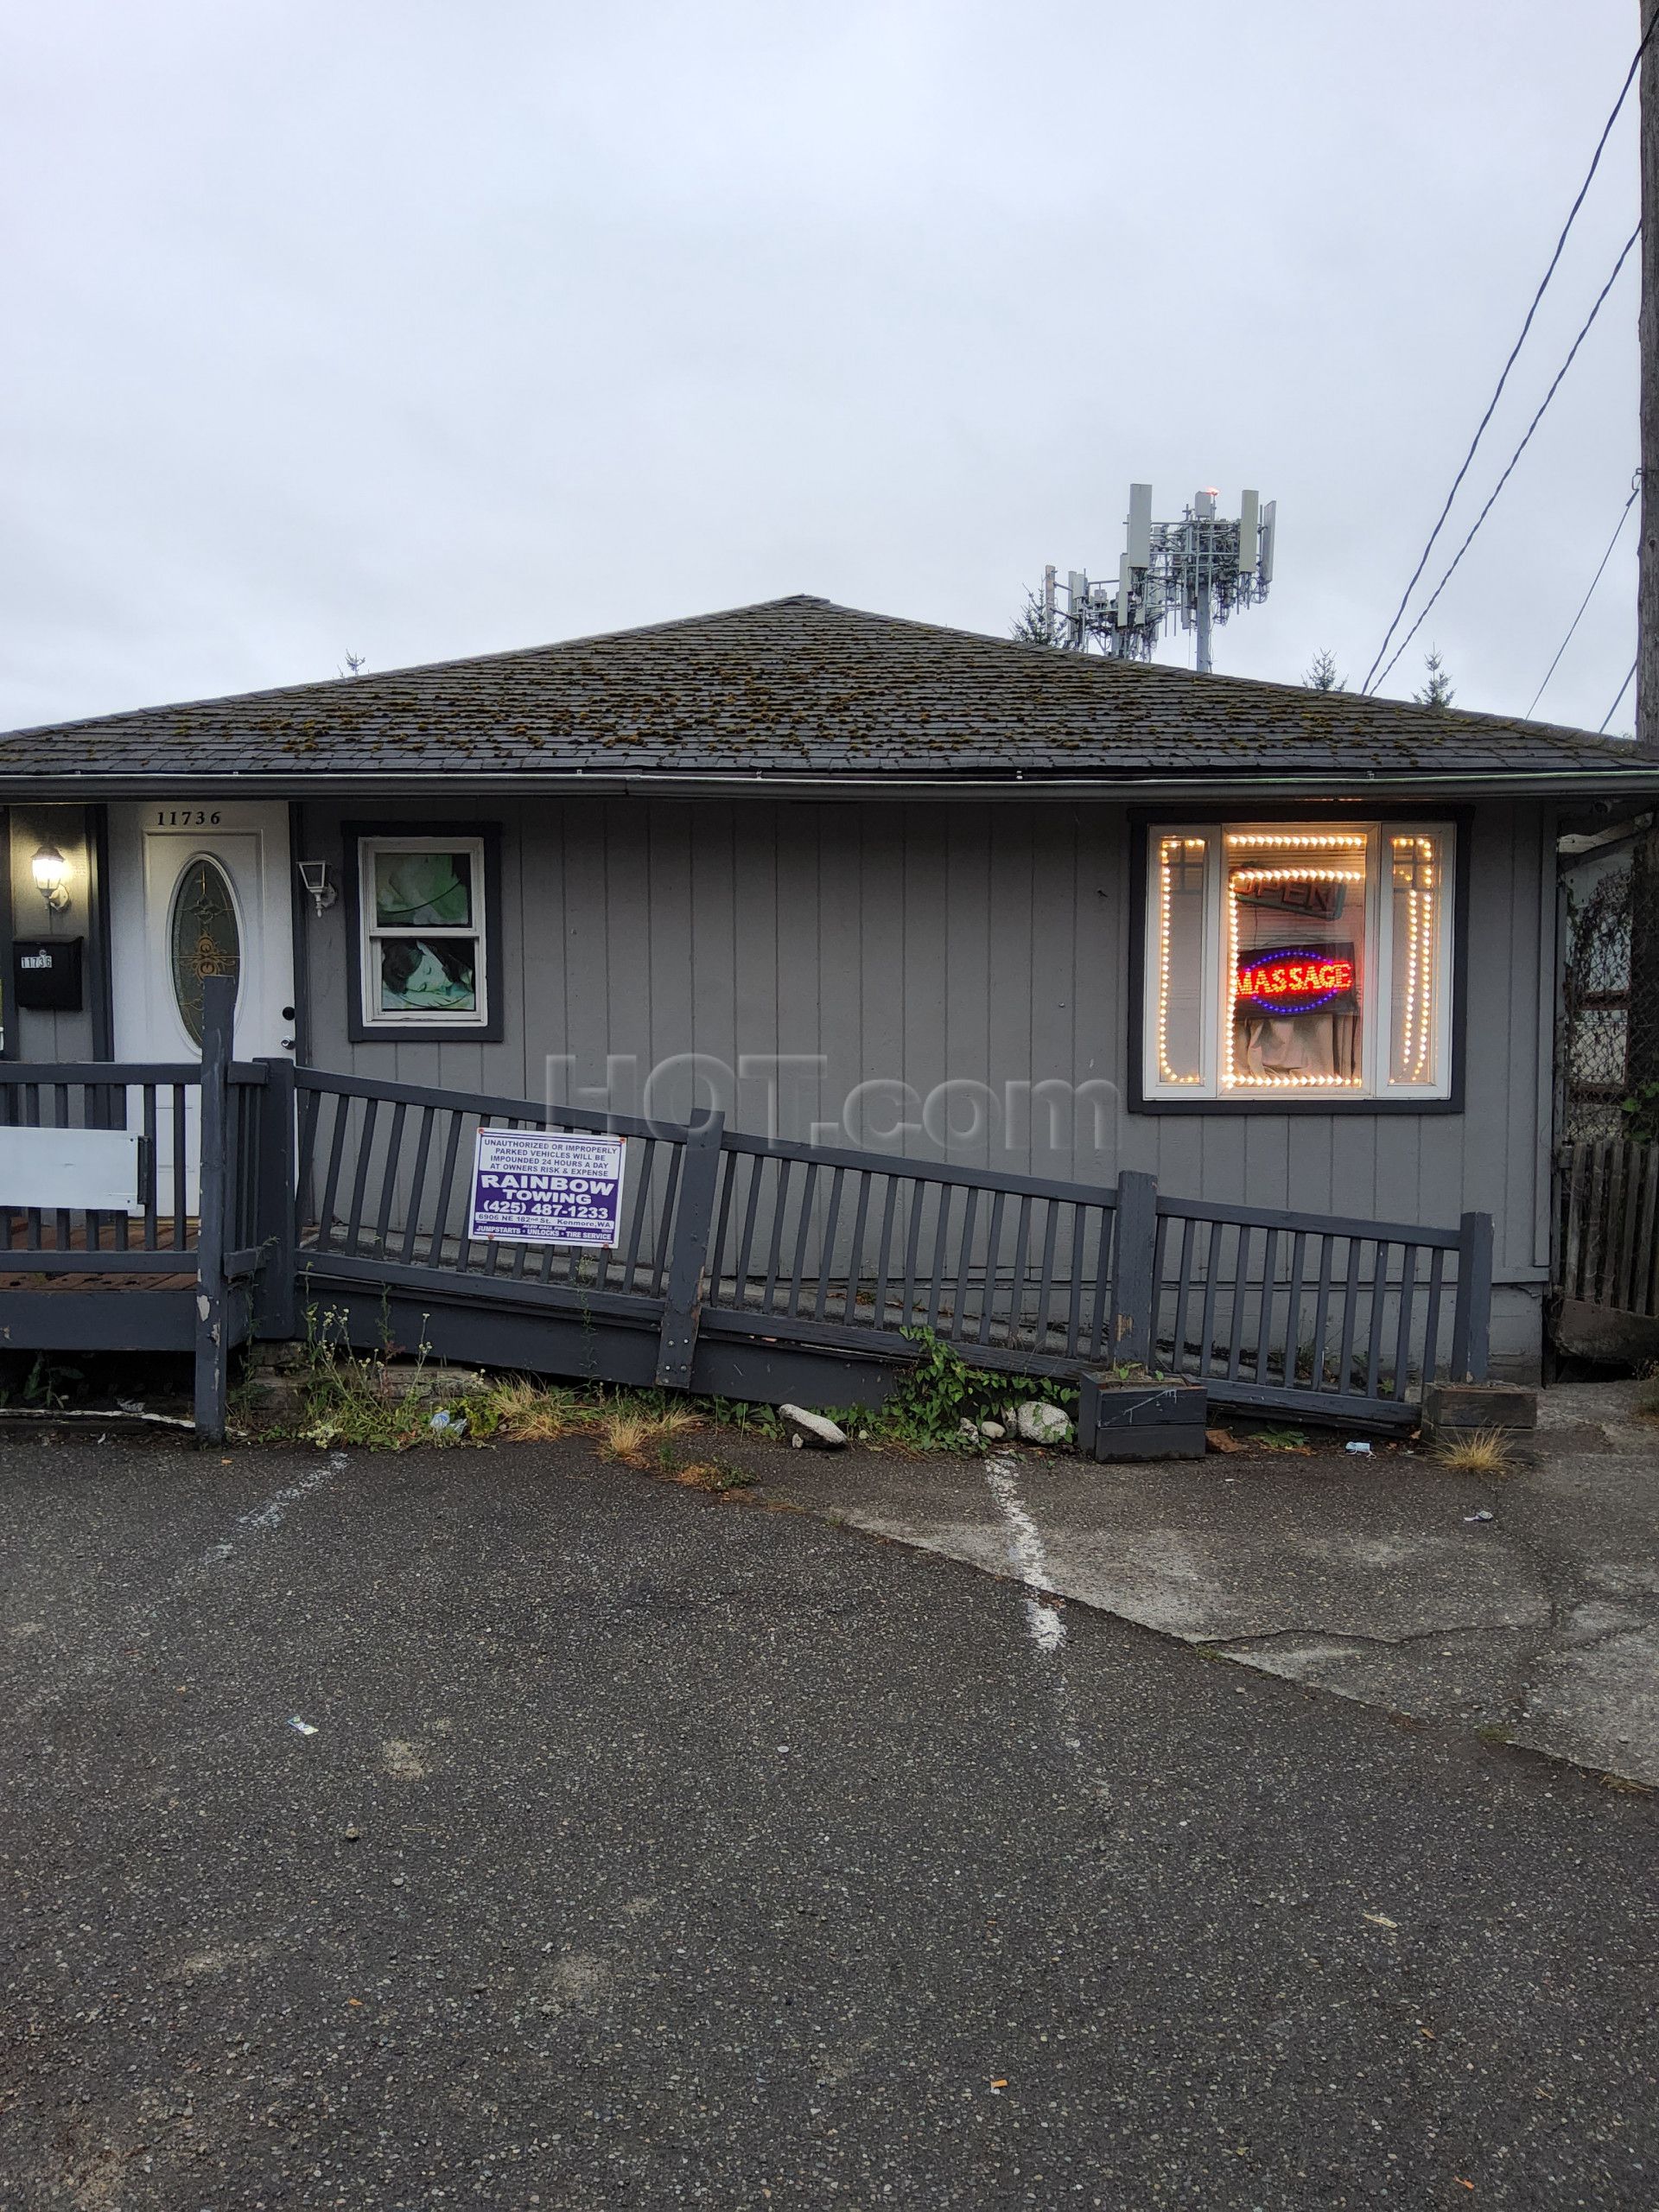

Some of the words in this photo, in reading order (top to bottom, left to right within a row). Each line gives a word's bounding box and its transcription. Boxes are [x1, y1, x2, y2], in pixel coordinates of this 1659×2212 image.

[157, 810, 222, 825] 11736
[22, 957, 51, 968] 11736
[1235, 963, 1353, 995] MASSAGE
[485, 1139, 549, 1149] UNAUTHORIZED
[565, 1145, 617, 1154] IMPROPERLY
[491, 1155, 539, 1165] IMPOUNDED
[531, 1150, 570, 1159] VEHICLES
[503, 1164, 537, 1173] OWNERS
[571, 1168, 608, 1177] EXPENSE
[480, 1175, 614, 1196] RAINBOW
[502, 1189, 592, 1205] TOWING
[484, 1200, 526, 1214] (425)
[531, 1203, 608, 1219] 487-1233
[476, 1225, 521, 1234] JUMPSTARTS
